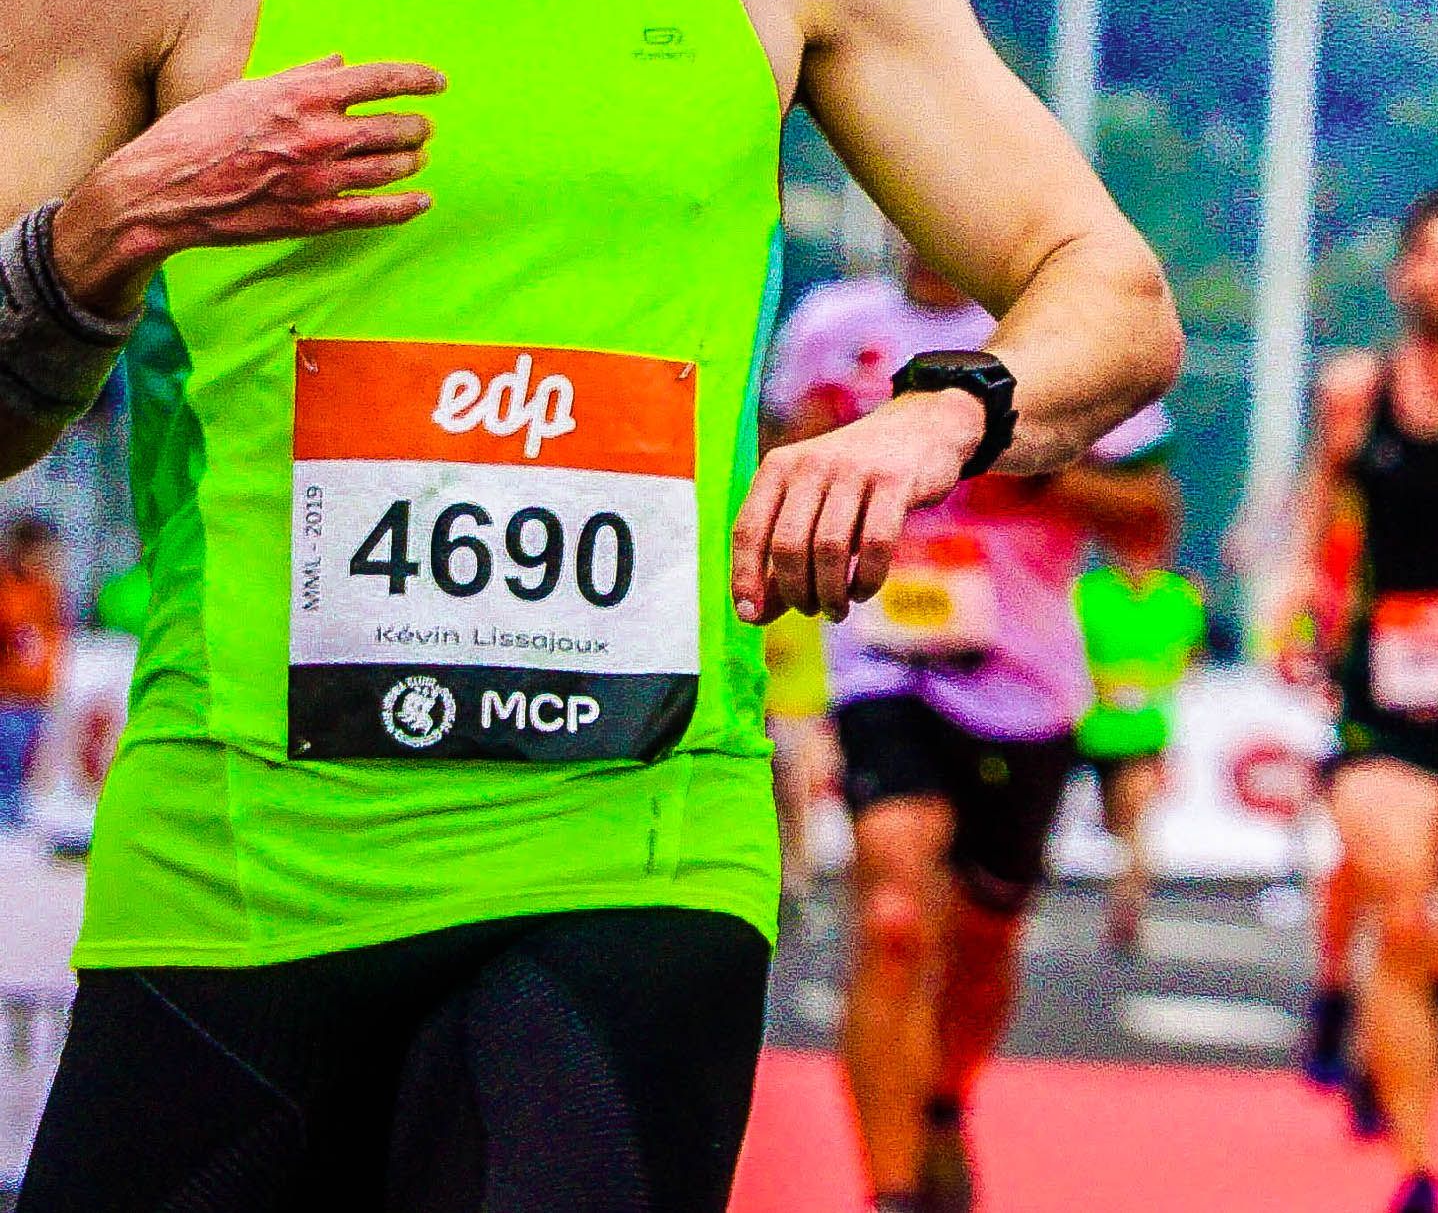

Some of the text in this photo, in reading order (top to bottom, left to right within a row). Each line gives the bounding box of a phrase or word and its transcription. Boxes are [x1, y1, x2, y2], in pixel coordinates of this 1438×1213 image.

[431, 352, 577, 459] edp
[304, 486, 322, 536] 2019
[348, 499, 636, 609] 4690
[480, 689, 601, 734] MCP
